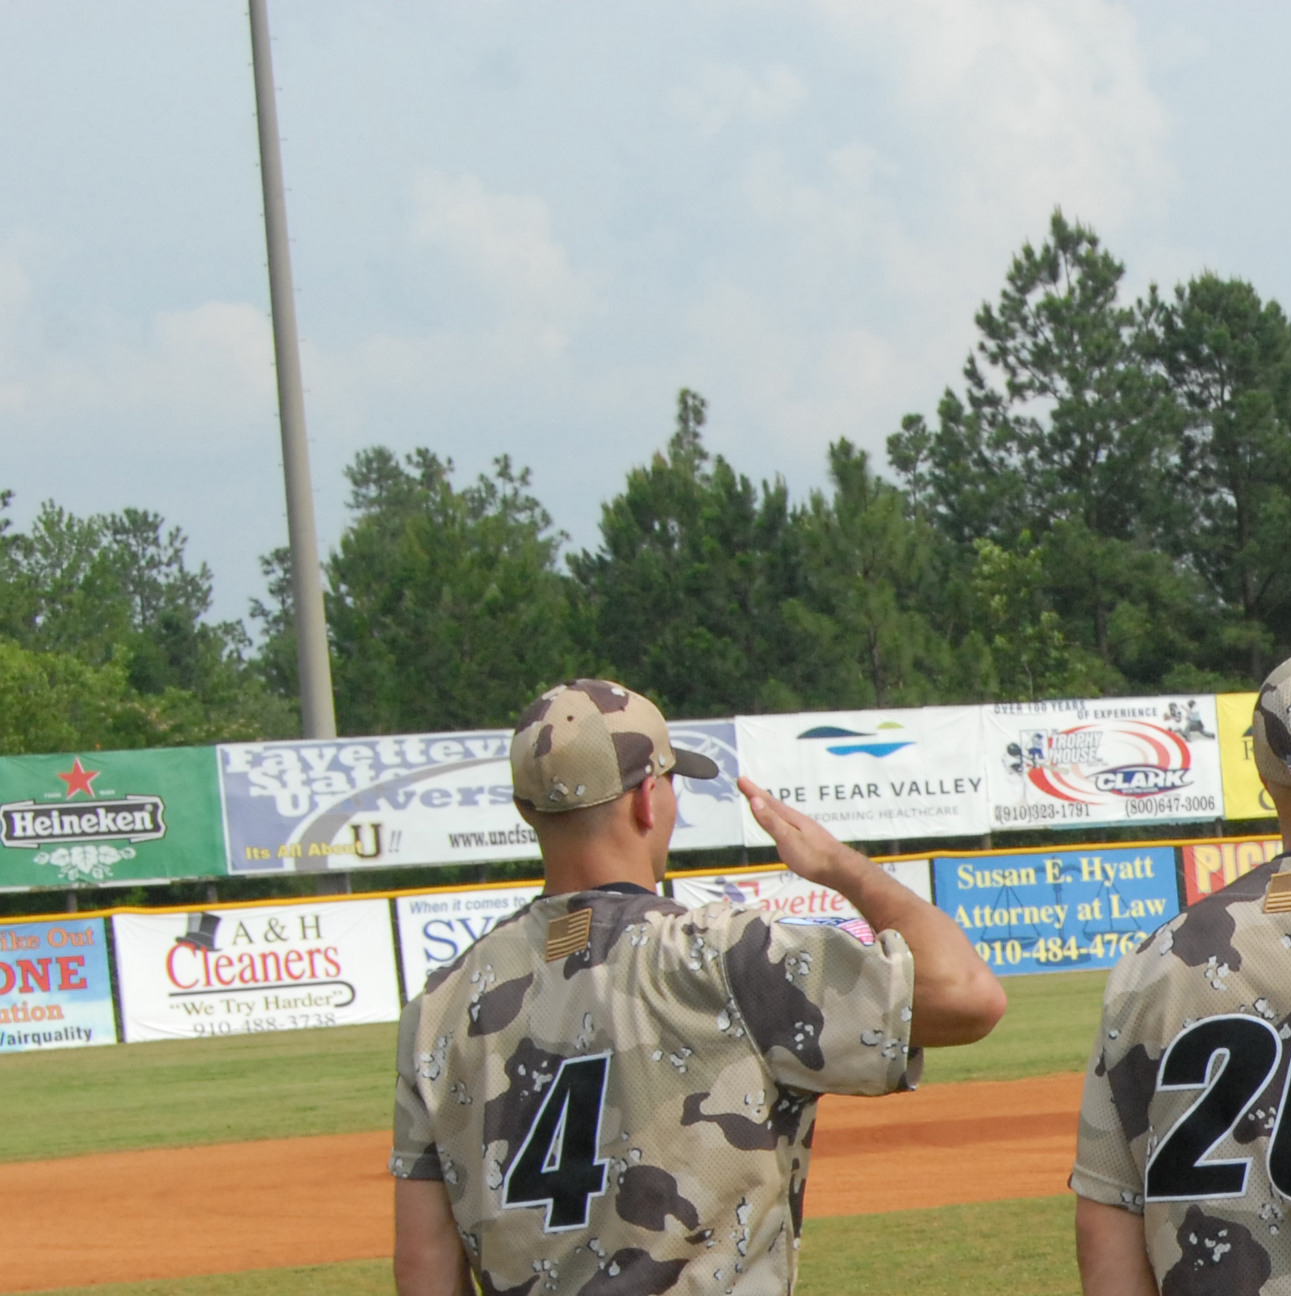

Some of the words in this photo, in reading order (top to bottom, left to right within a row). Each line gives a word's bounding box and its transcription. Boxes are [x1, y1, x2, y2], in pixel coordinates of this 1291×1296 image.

[1051, 700, 1086, 712] YEARS
[1077, 709, 1091, 720] OF
[1094, 706, 1159, 719] EXPERIENCE
[1052, 731, 1103, 749] TROPHY
[1051, 747, 1099, 765] HOUSE
[818, 783, 881, 802] FEAR
[891, 777, 982, 798] VALLEY
[1095, 769, 1188, 792] CLARK
[11, 807, 154, 838] Heineken
[808, 810, 874, 823] FORMING
[878, 805, 959, 819] HEALTHCARE
[245, 846, 271, 860] Its
[277, 844, 302, 858] All
[308, 841, 363, 857] About
[957, 863, 1037, 889] Susan
[1042, 857, 1073, 884] E.
[1079, 855, 1155, 887] Hyatt
[410, 899, 448, 914] When
[452, 898, 461, 911] it
[465, 897, 509, 911] comes
[954, 903, 1069, 929] Attorney
[1077, 898, 1103, 921] at
[1109, 894, 1167, 919] Law
[47, 926, 94, 948] Out
[232, 920, 254, 945] A
[264, 916, 289, 943] &
[299, 914, 323, 940] H
[166, 941, 341, 989] Cleaners
[220, 998, 251, 1016] Try
[502, 1050, 614, 1233] 4
